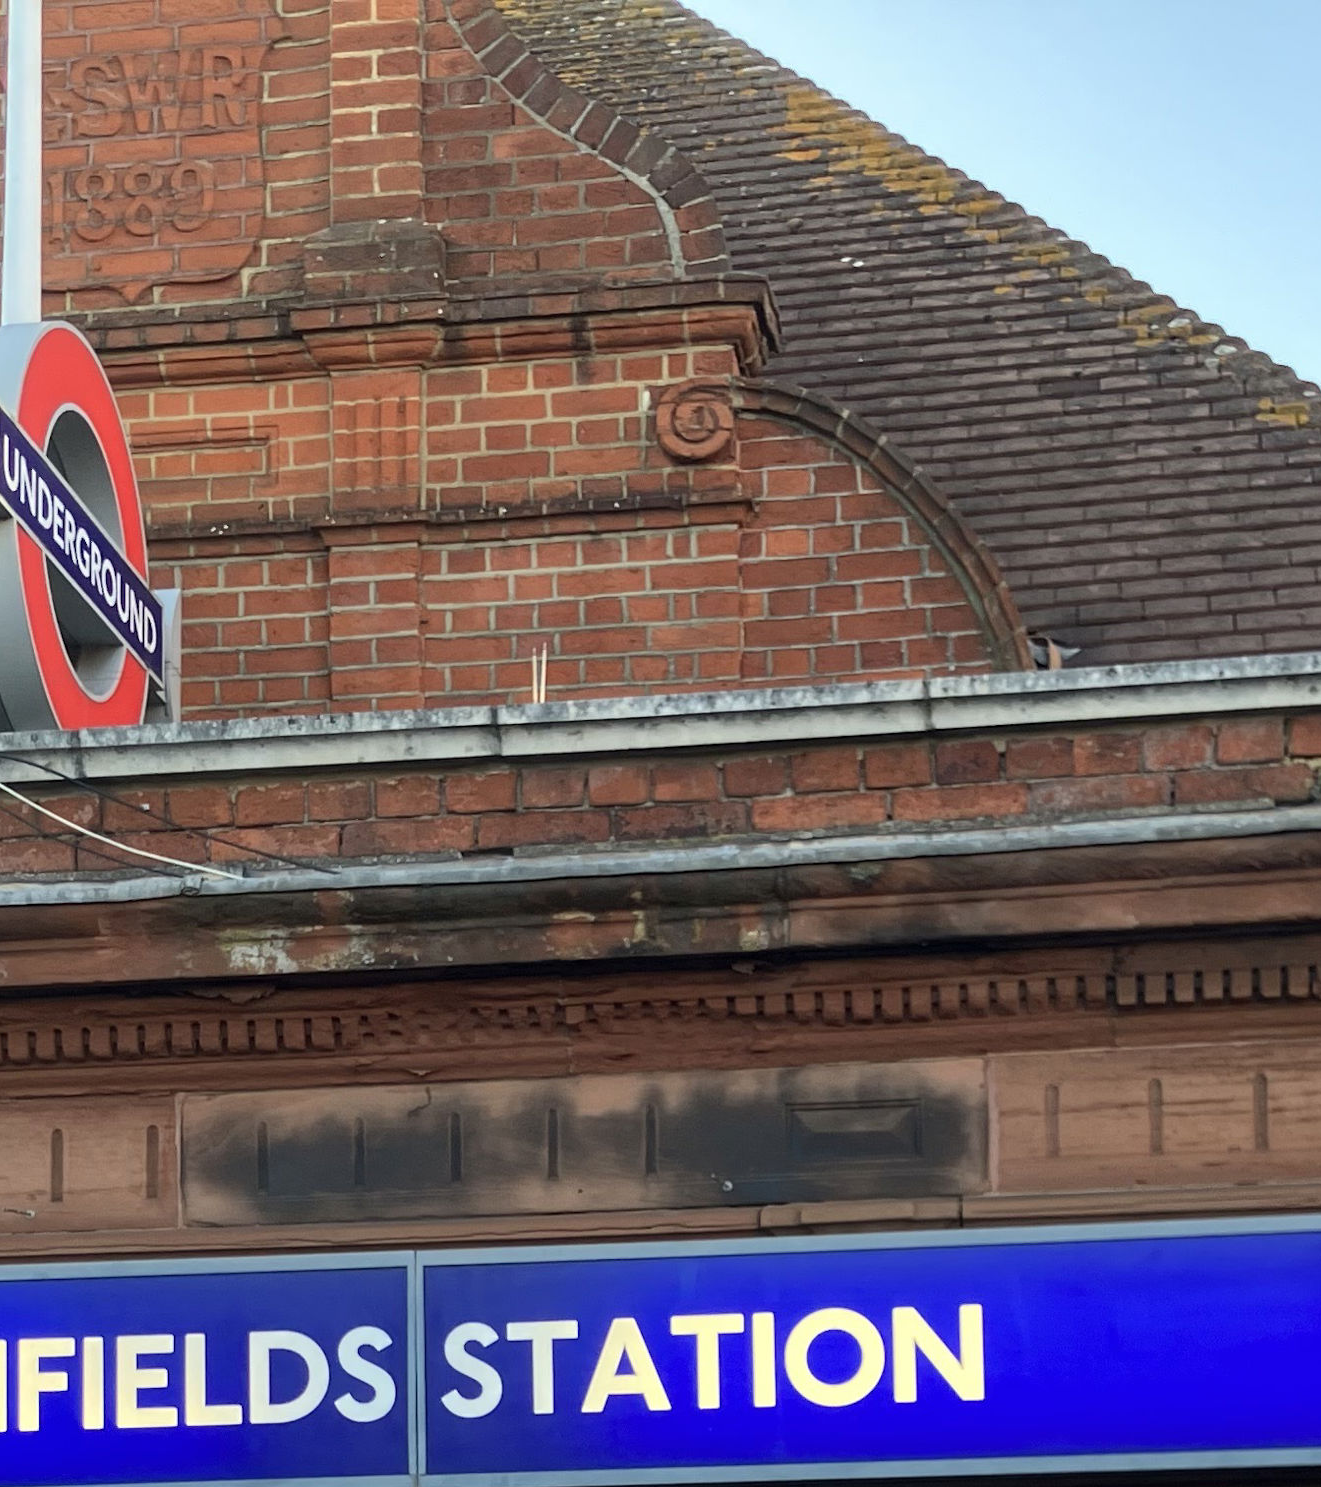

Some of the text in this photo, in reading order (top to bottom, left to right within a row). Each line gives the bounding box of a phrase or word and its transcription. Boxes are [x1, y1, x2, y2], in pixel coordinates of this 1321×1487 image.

[48, 159, 215, 244] 1889
[3, 434, 157, 653] UNDERGROUND
[440, 1302, 986, 1419] STATION
